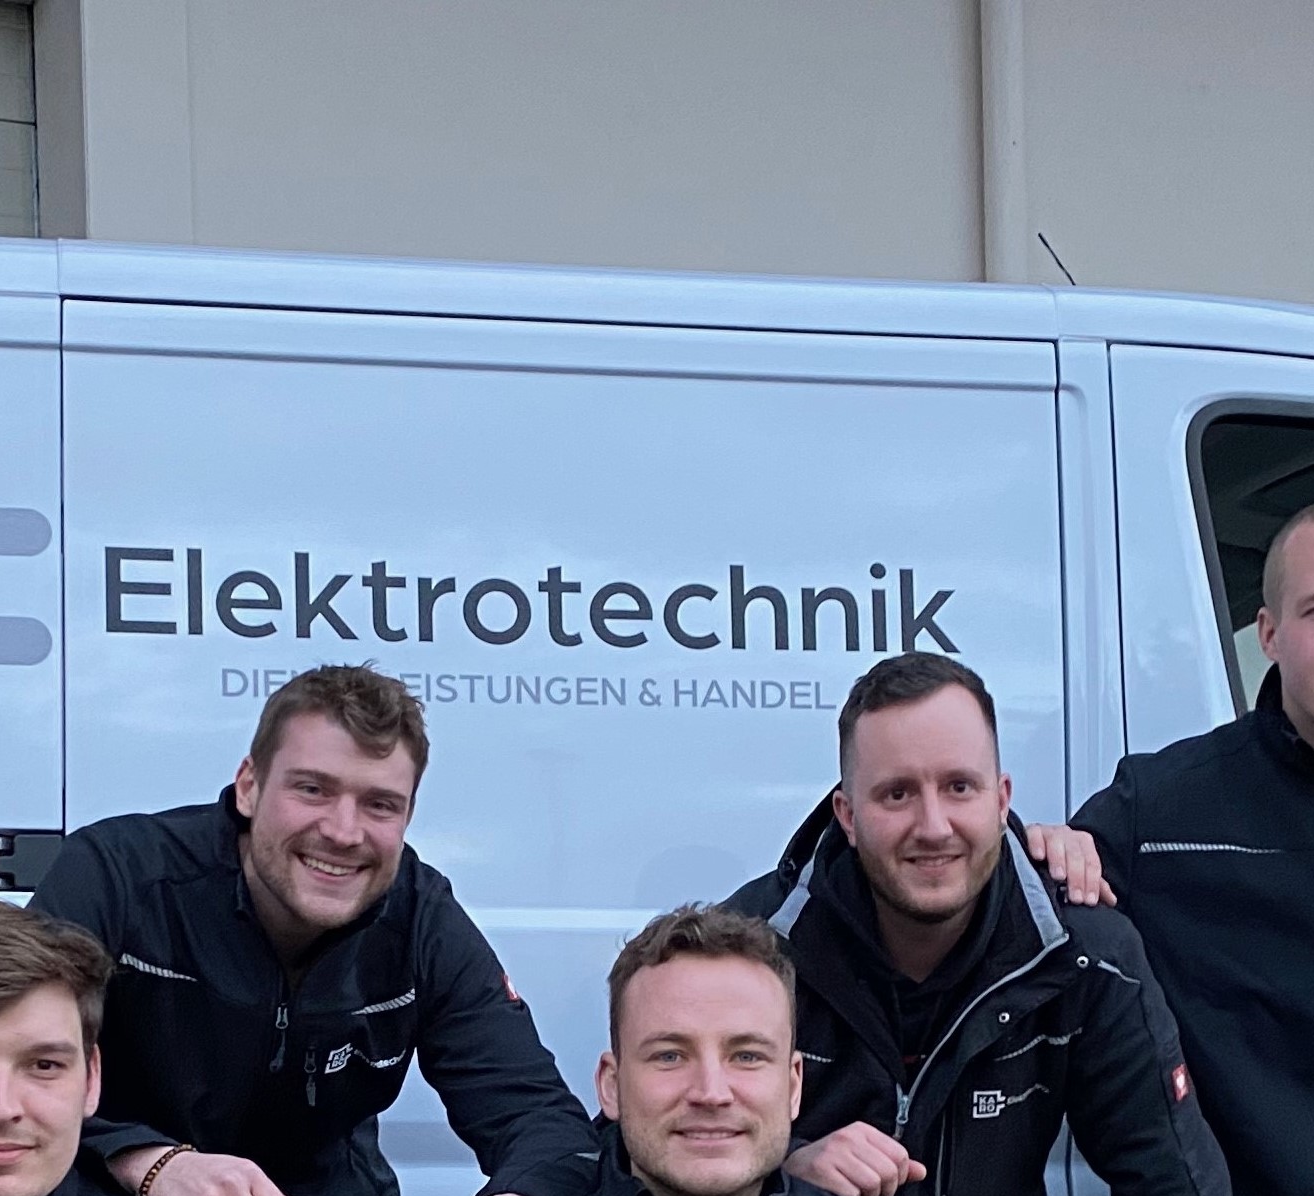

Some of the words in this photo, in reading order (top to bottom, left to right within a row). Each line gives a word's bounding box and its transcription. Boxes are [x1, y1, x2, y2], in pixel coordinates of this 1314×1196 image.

[104, 545, 961, 653] Elektrotechnik
[221, 668, 627, 706] DIEEISTUNGEN
[638, 678, 662, 707] &
[673, 678, 837, 710] HANDEL
[978, 1096, 996, 1105] KA
[978, 1104, 995, 1113] RO
